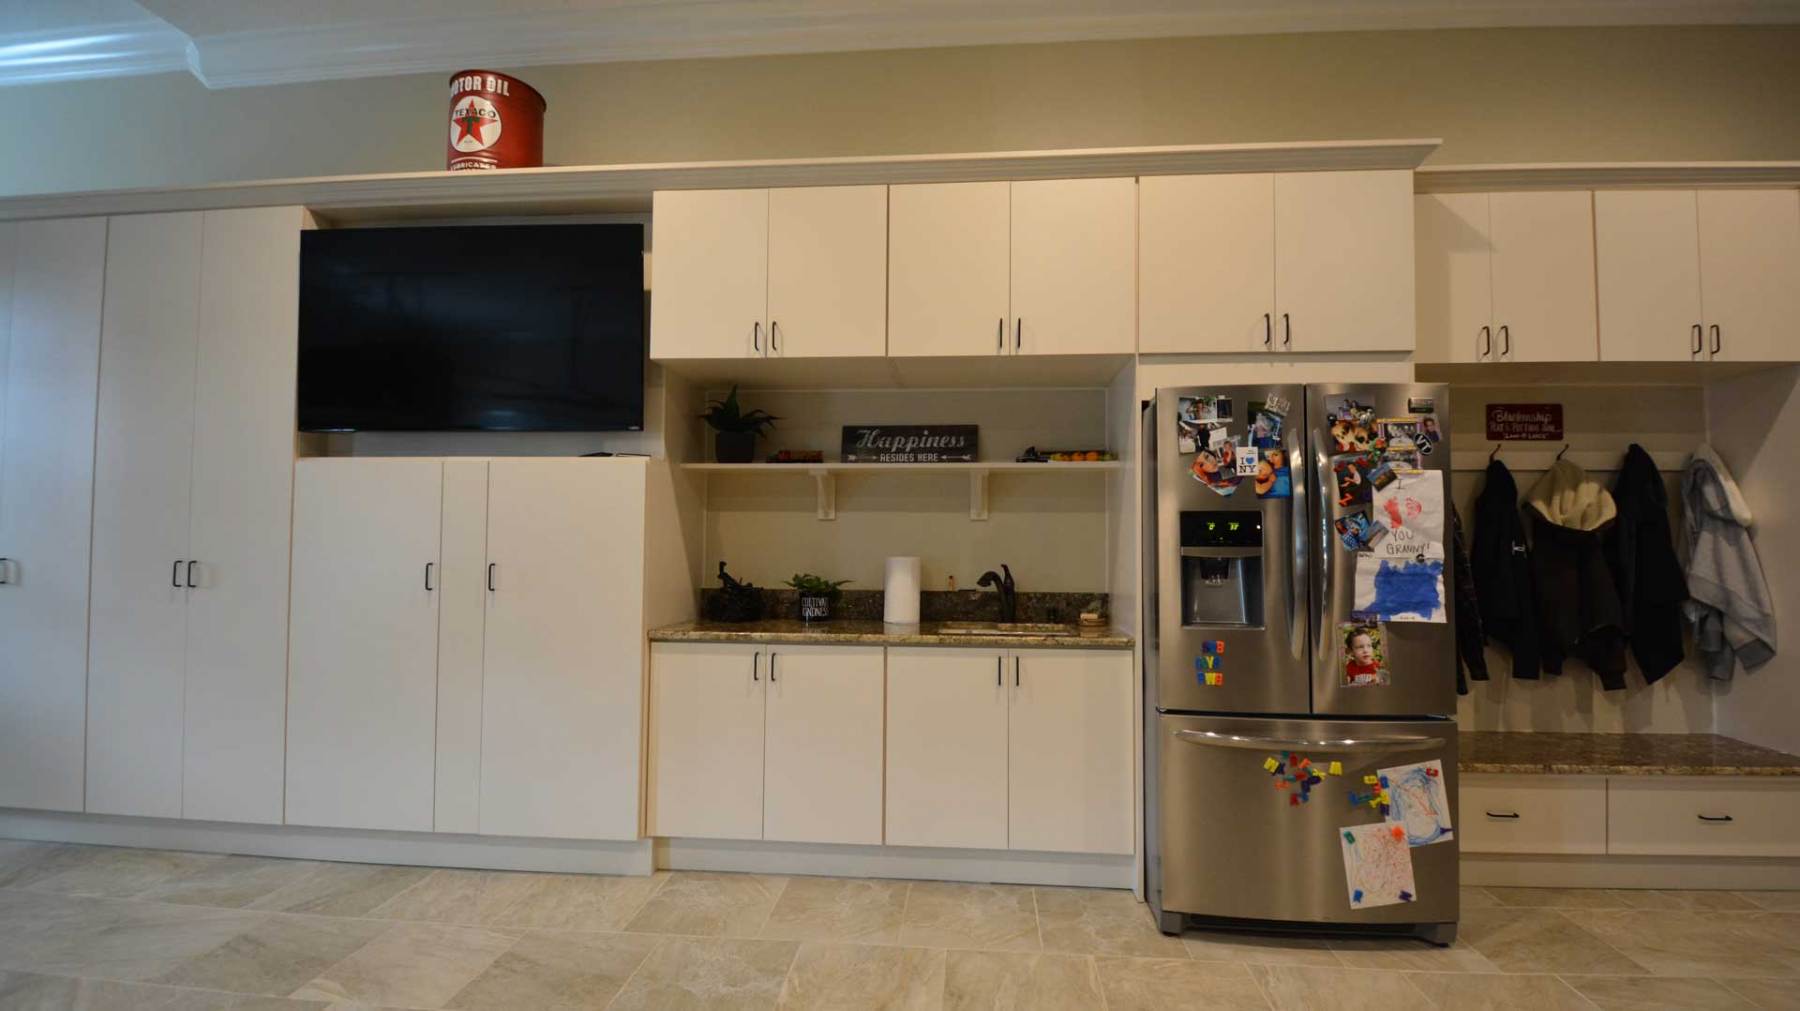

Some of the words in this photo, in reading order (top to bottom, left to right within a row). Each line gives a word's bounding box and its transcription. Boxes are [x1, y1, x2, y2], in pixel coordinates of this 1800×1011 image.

[486, 77, 510, 96] OIL
[455, 108, 497, 119] TEXACO
[856, 429, 965, 453] Happiness
[880, 453, 914, 462] RESIDES
[917, 453, 939, 462] HERE
[1239, 465, 1257, 473] NY
[1392, 529, 1414, 541] YOU
